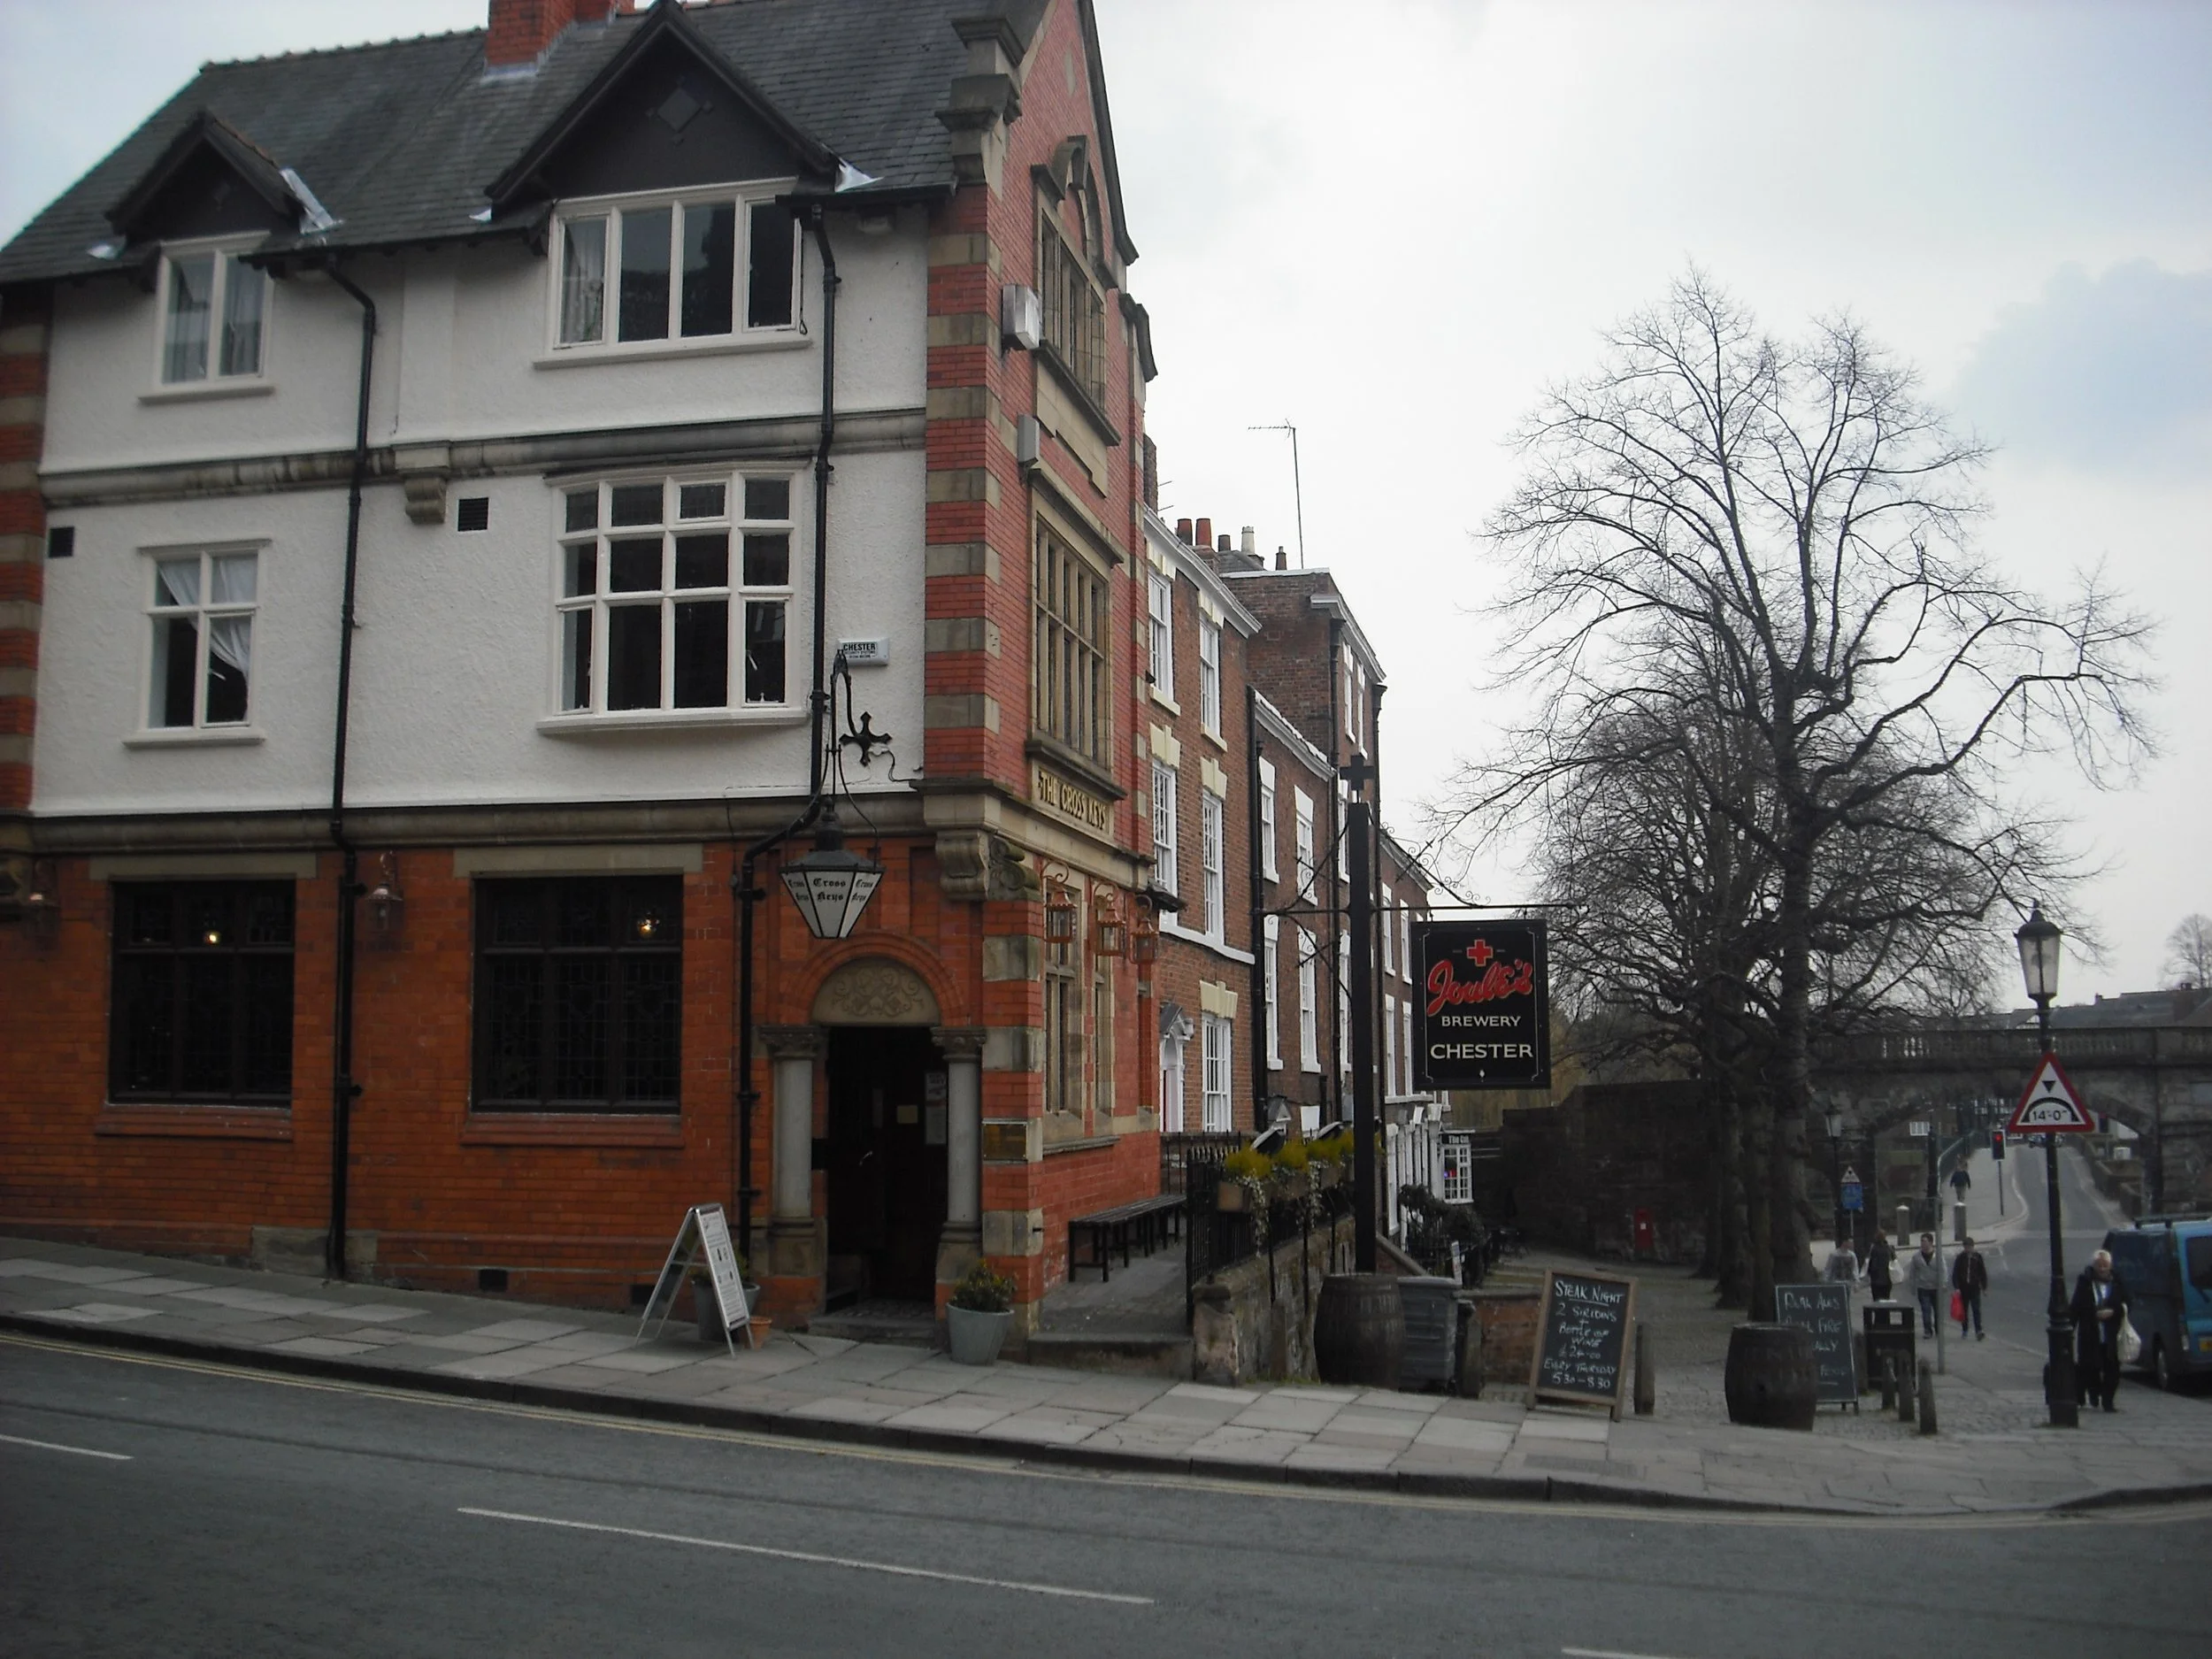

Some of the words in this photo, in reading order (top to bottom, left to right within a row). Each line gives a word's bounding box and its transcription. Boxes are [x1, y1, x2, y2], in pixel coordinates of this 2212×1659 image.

[1039, 767, 1059, 806] THE
[1060, 783, 1085, 820] CROSS
[1087, 797, 1108, 831] KEYS
[813, 877, 847, 887] Cross
[817, 891, 844, 902] Keys
[1426, 958, 1533, 1018] Joule's
[1441, 1016, 1521, 1027] BREWERY
[1430, 1043, 1533, 1059] CHESTER
[1555, 1302, 1566, 1317] 2
